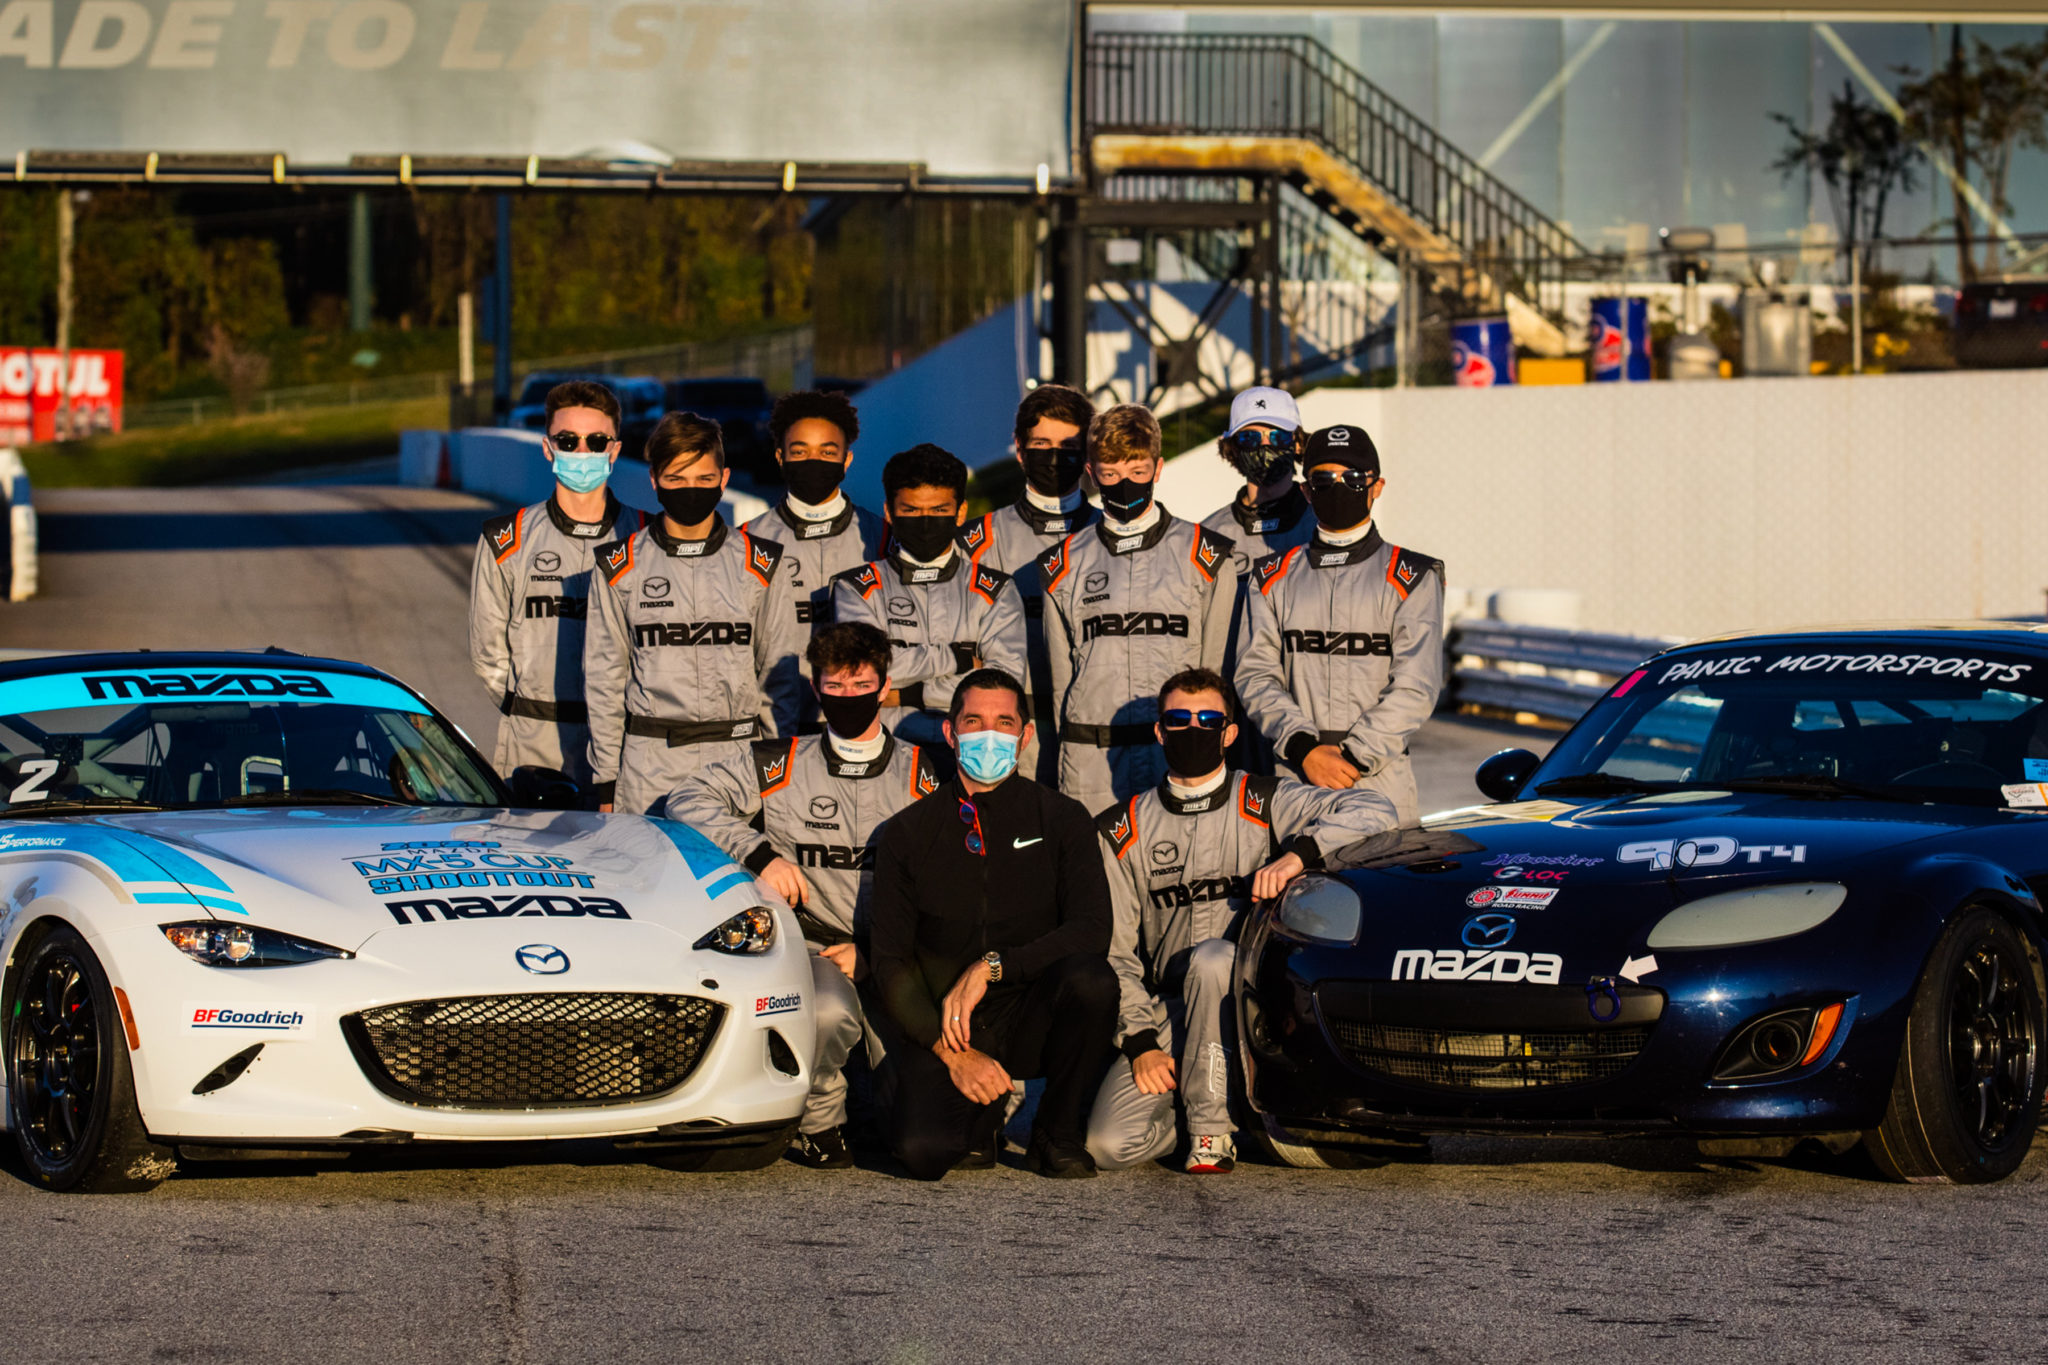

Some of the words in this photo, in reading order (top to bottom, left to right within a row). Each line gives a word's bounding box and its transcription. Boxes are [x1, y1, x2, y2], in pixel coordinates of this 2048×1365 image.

[264, 0, 415, 70] TO
[0, 353, 110, 396] OTUL
[1658, 656, 1762, 684] PANIC
[1766, 655, 2032, 683] MOTORSPORTS
[9, 760, 59, 804] 2
[352, 853, 475, 876] MX-5
[481, 853, 573, 870] CUP
[369, 871, 595, 894] SHOOTOUT
[193, 1009, 304, 1024] BFGoodrich
